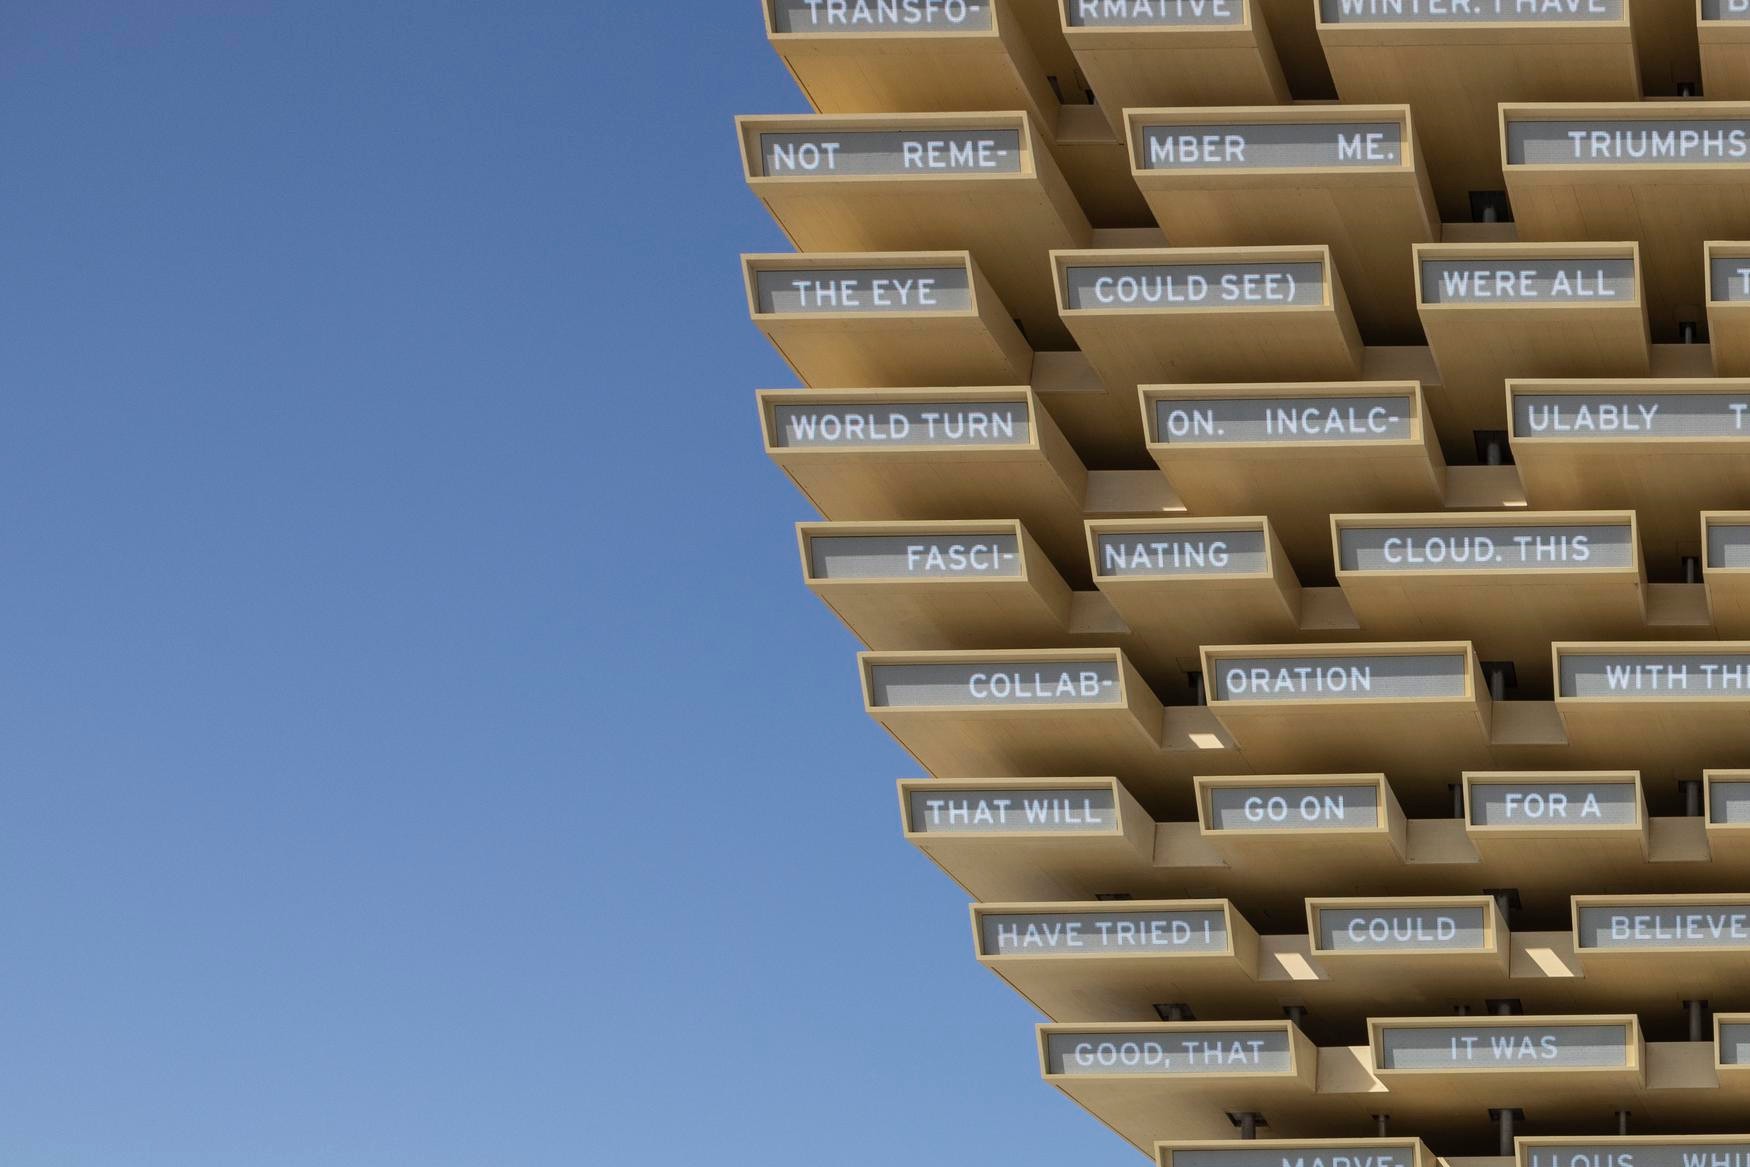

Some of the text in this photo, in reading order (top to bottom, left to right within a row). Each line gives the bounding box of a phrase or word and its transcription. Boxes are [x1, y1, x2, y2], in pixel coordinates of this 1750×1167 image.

[804, 0, 980, 25] TRANSFO-
[774, 140, 1007, 170] NOT REME-
[1150, 133, 1394, 163] MBER ME.
[1568, 130, 1747, 158] TRIUMPHS
[792, 279, 937, 306] THE EYE
[1094, 274, 1295, 303] COULD SEE)
[1443, 270, 1615, 297] WERE ALL
[791, 412, 1013, 441] WORLD TURN
[1168, 407, 1399, 436] ON. INCALC-
[1529, 404, 1658, 431] ULABLY
[907, 544, 1014, 570] FASCI-
[1105, 542, 1229, 568] NATING
[1384, 536, 1590, 563] CLOUD. THIS
[969, 672, 1113, 698] COLLAB-
[1226, 667, 1370, 693] ORATION
[1606, 665, 1687, 690] WITH
[927, 799, 1102, 824] THAT WILL
[1244, 796, 1344, 822] GO ON
[1505, 793, 1601, 818] FOR A
[998, 920, 1210, 947] HAVE TRIED I
[1348, 917, 1456, 942] COULD
[1611, 914, 1747, 939] BELIEVE
[1075, 1041, 1264, 1068] GOOD, THAT
[1451, 1036, 1557, 1060] IT WAS
